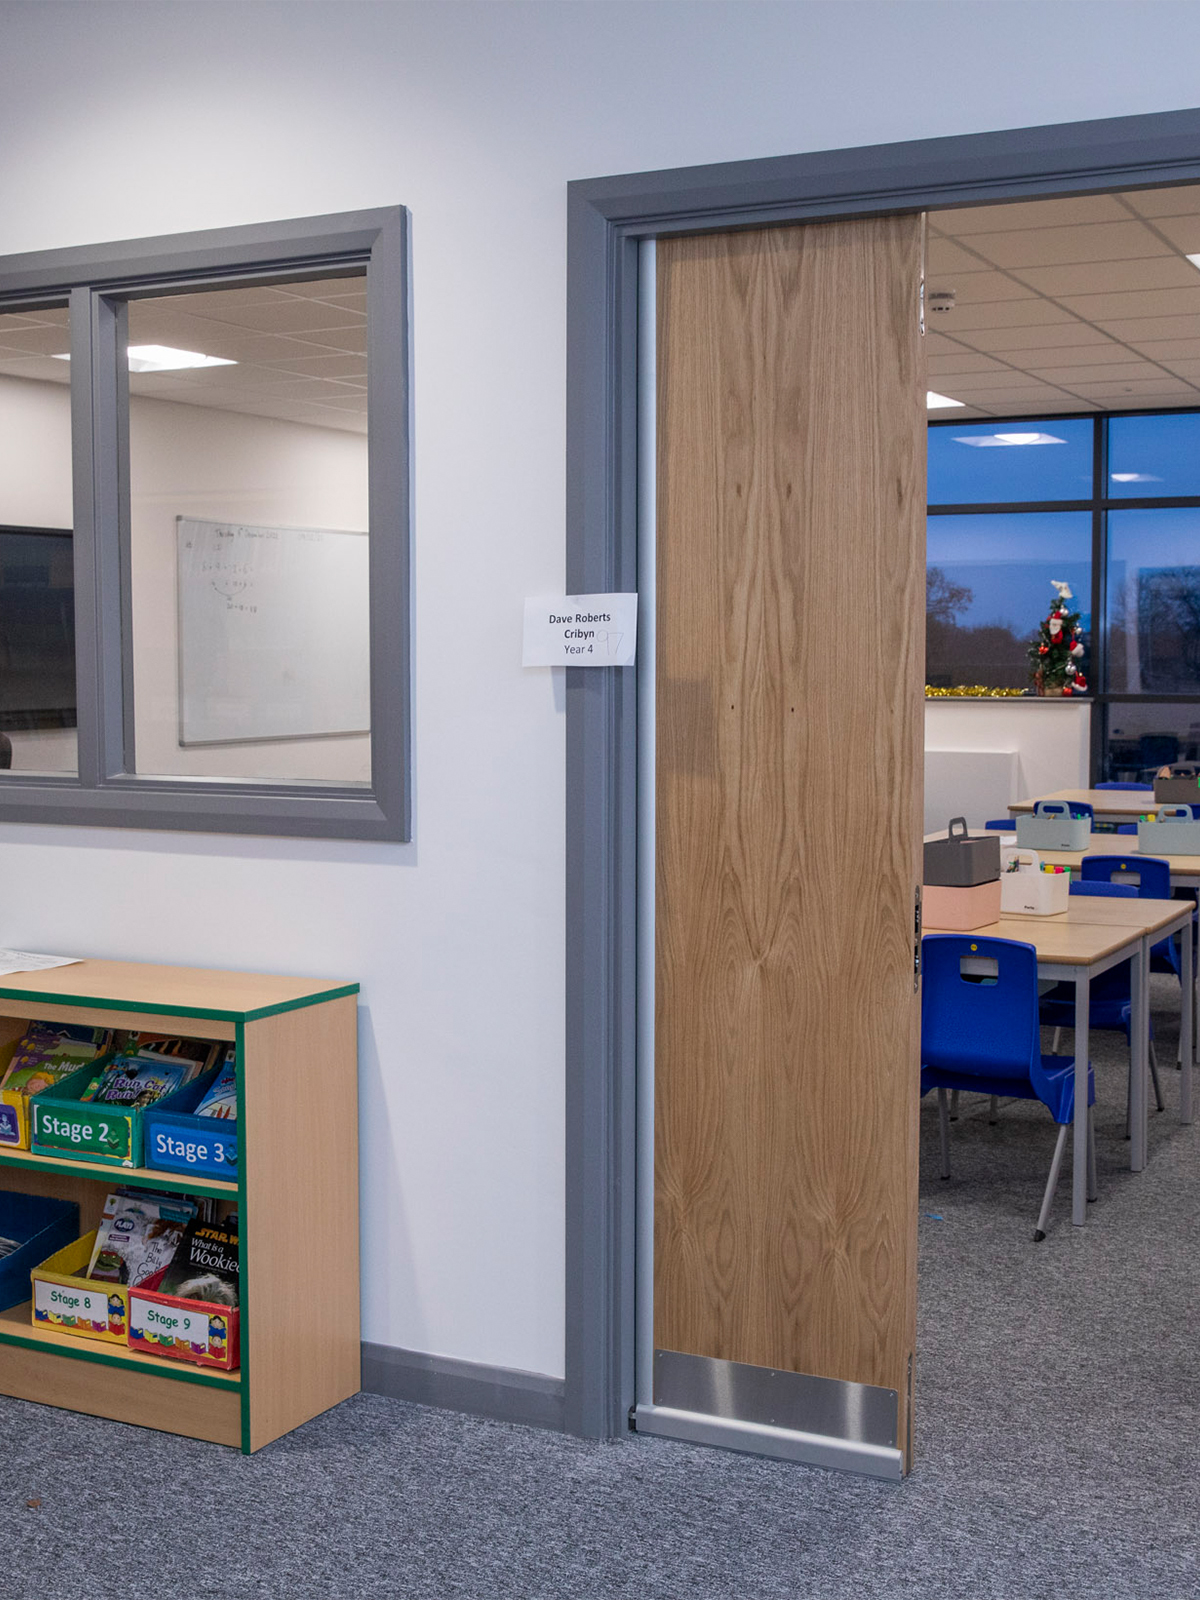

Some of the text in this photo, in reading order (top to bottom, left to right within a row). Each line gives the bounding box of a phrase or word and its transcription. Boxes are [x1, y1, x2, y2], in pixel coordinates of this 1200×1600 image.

[549, 613, 611, 624] Dave Roberts
[564, 629, 595, 640] Cribyn
[564, 644, 594, 654] Year 4
[44, 1062, 57, 1071] The
[42, 1114, 109, 1143] Stage 2
[156, 1133, 225, 1163] Stage 3
[194, 1227, 228, 1243] STAR
[150, 1241, 163, 1254] The
[191, 1237, 212, 1250] What
[211, 1243, 219, 1252] is
[50, 1290, 92, 1309] Stage 8
[147, 1310, 191, 1330] Stage 9
